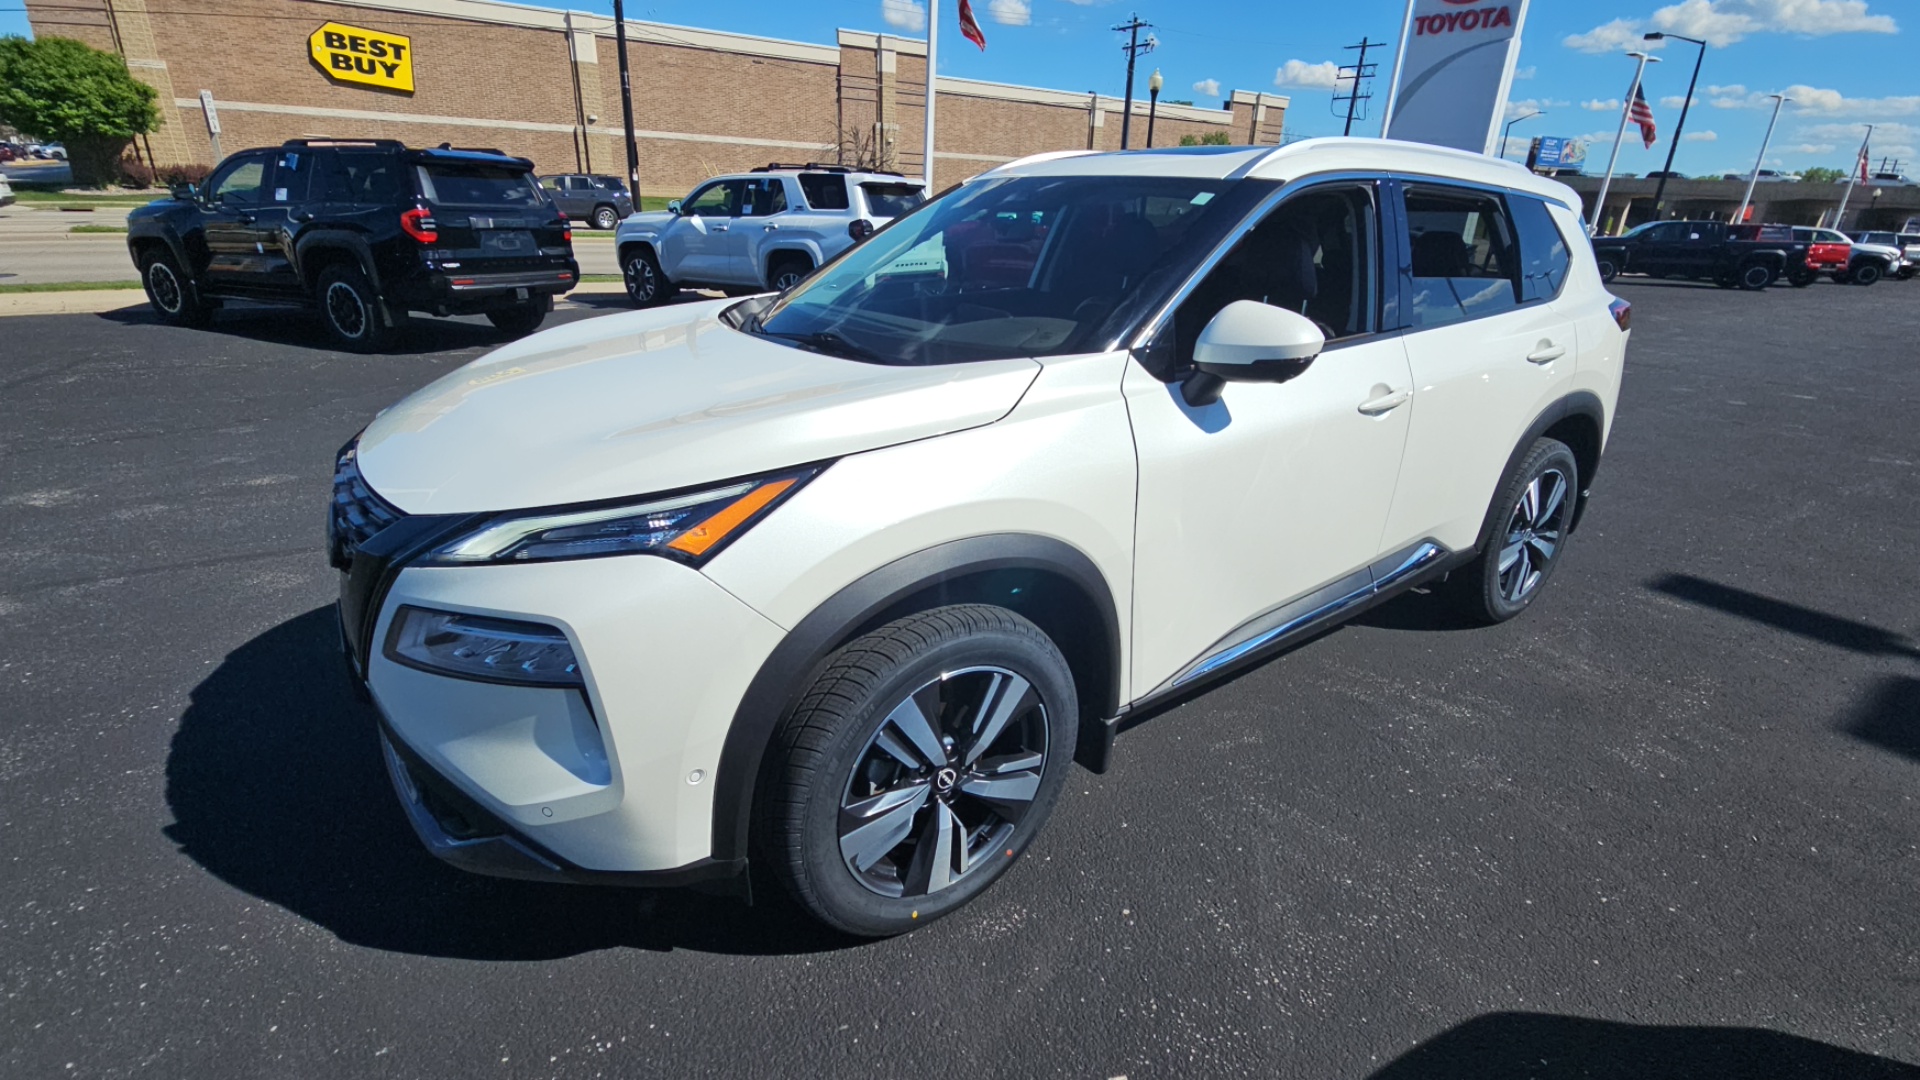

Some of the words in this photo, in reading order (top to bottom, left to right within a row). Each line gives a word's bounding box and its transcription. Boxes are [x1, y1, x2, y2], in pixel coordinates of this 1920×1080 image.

[1415, 6, 1512, 36] TOYOTA
[323, 31, 406, 61] BEST
[330, 52, 401, 79] BUY
